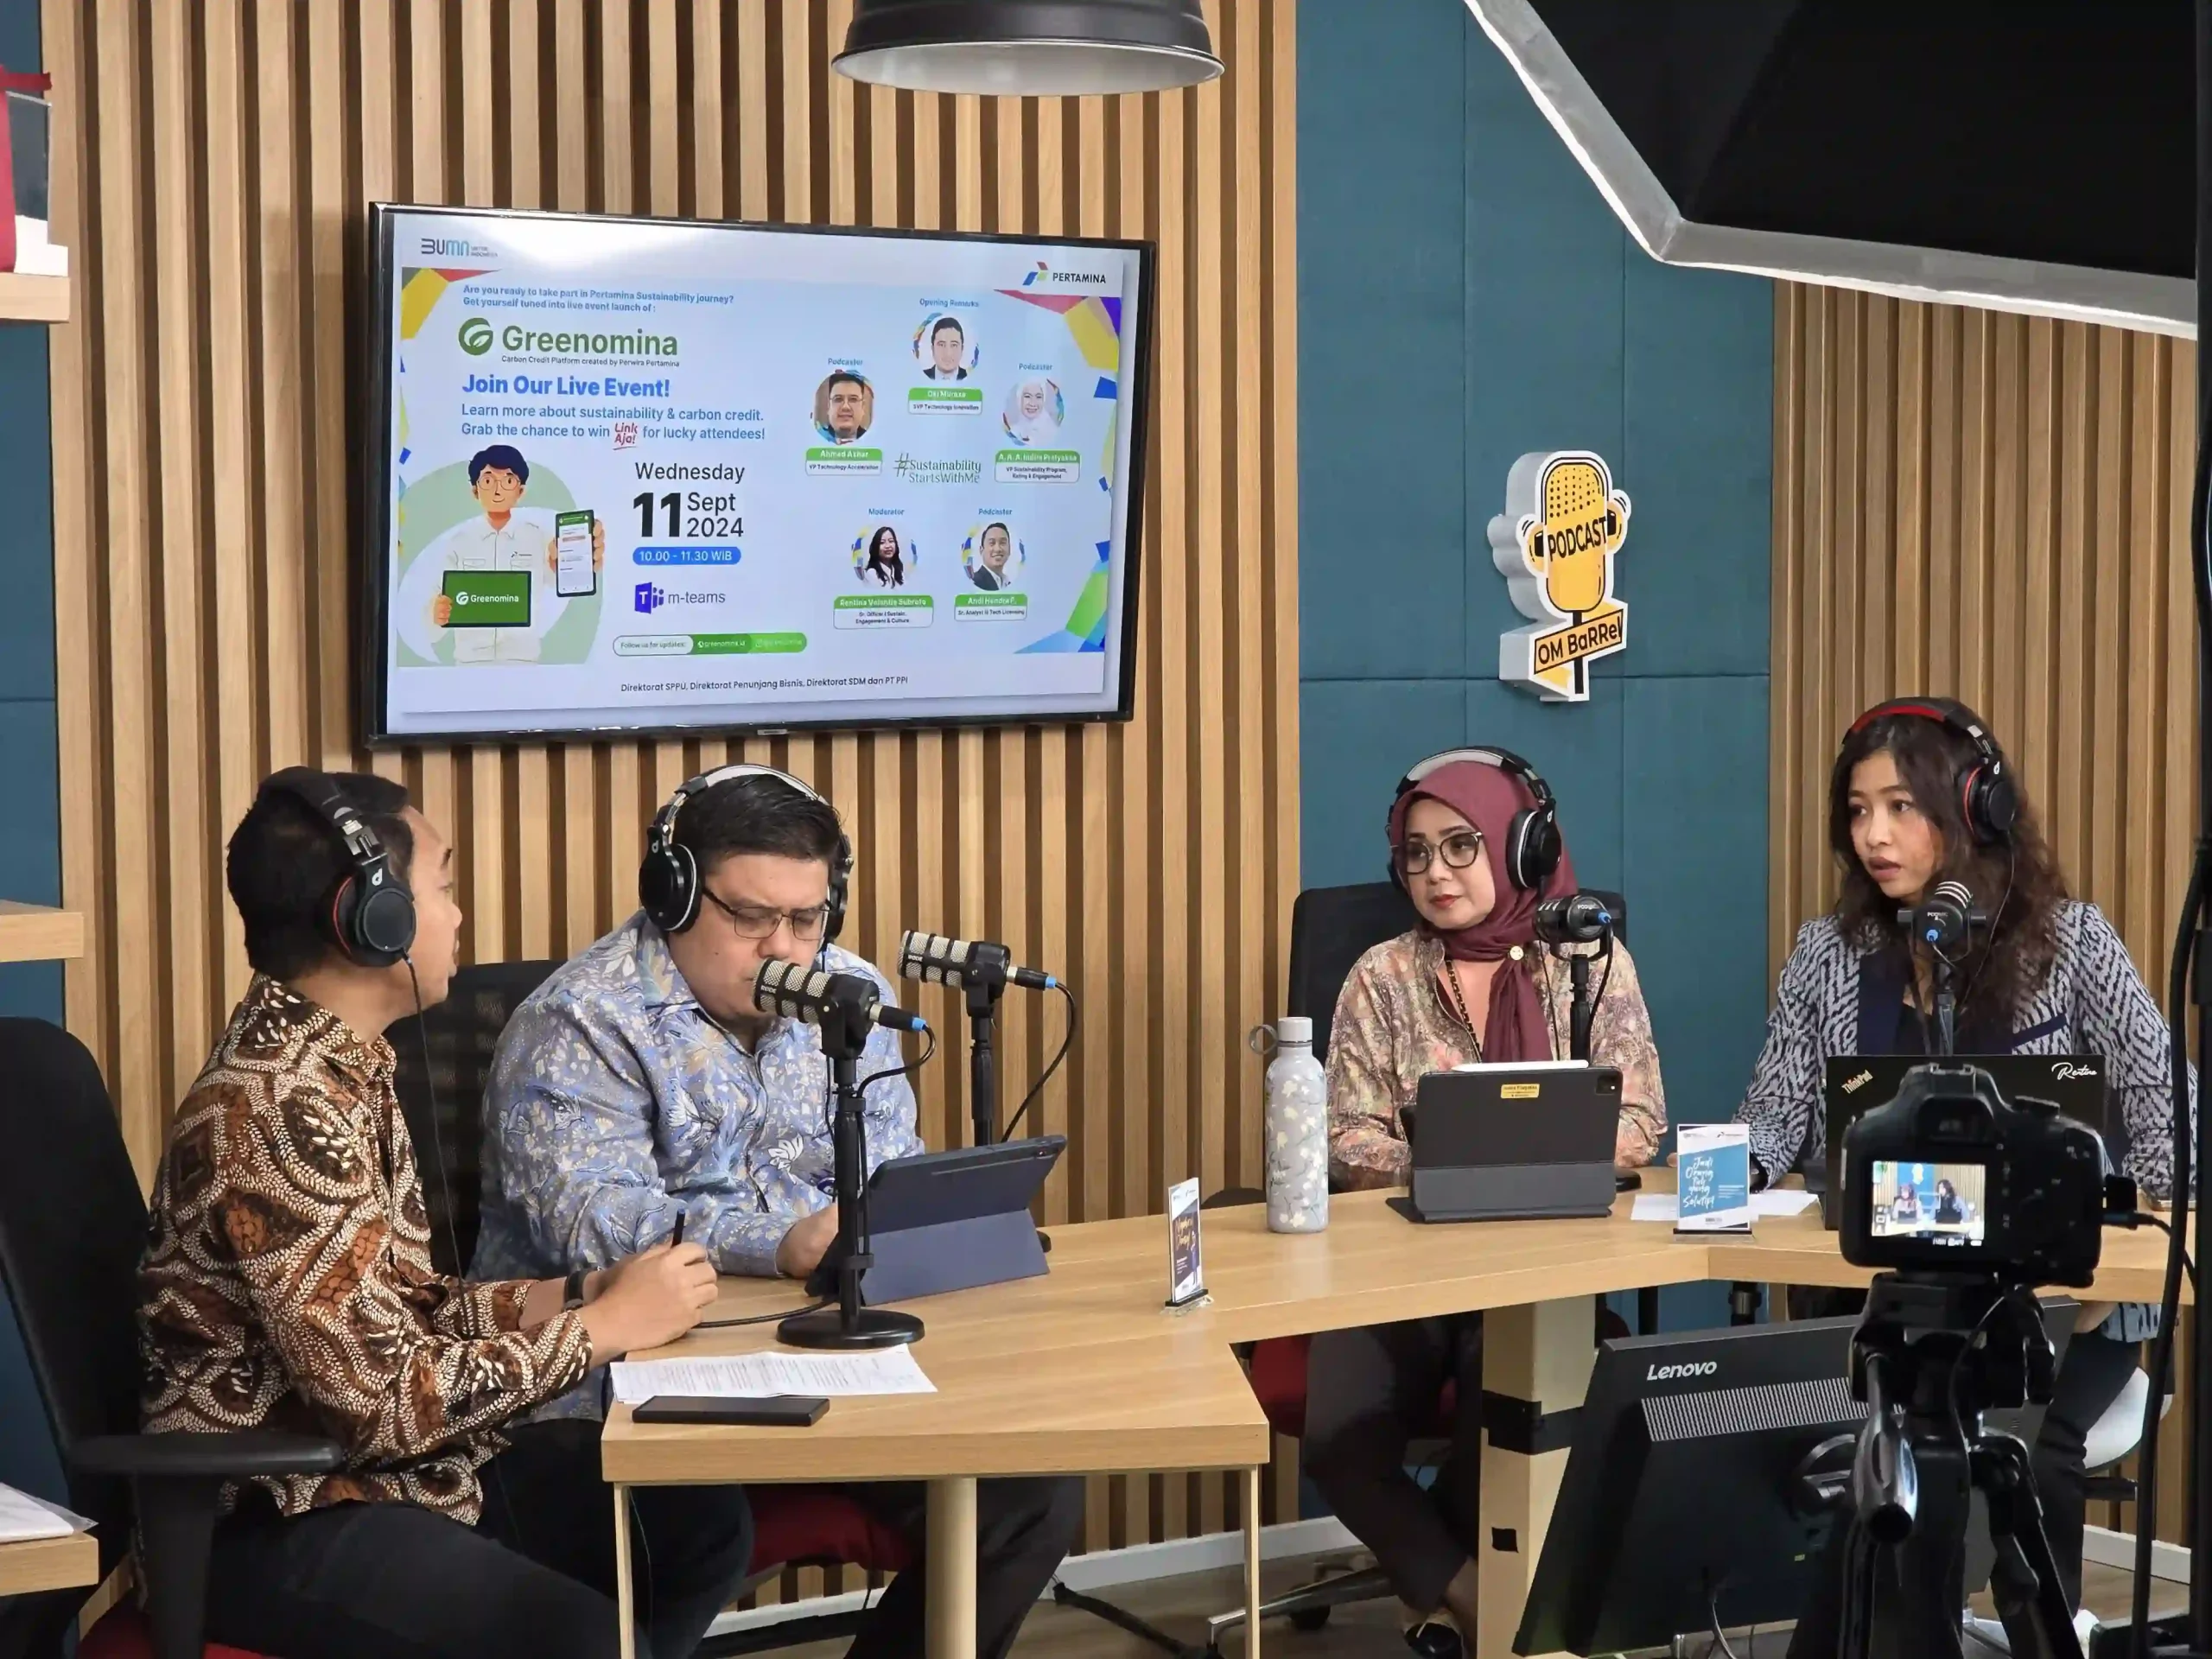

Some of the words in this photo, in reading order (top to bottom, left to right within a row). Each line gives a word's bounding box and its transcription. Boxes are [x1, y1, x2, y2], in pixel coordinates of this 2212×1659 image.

[1052, 272, 1106, 284] PERTAMINA
[463, 284, 480, 294] Are
[481, 286, 499, 296] you
[500, 286, 525, 297] ready
[528, 287, 537, 296] to
[539, 286, 558, 297] take
[560, 289, 578, 299] part
[590, 290, 635, 300] Pertamina
[636, 291, 695, 303] Sustainability
[696, 294, 734, 305] journey?
[463, 297, 480, 306] Get
[481, 298, 519, 308] yourself
[520, 298, 546, 308] tuned
[548, 299, 566, 308] into
[567, 299, 583, 309] live
[585, 302, 609, 311] event
[612, 302, 640, 312] launch
[642, 302, 652, 312] of
[919, 298, 948, 308] Opening
[950, 299, 979, 308] Remarks
[502, 325, 677, 356] Greenomina
[502, 355, 527, 364] Carbon
[529, 355, 550, 364] Credit
[609, 359, 618, 367] by
[646, 359, 679, 368] Pertamina
[461, 374, 508, 393] Join
[513, 375, 553, 395] Our
[557, 375, 600, 396] Live
[605, 378, 670, 397] Event!
[461, 404, 499, 417] Learn
[502, 406, 536, 417] more
[539, 405, 575, 418] about
[580, 406, 664, 422] sustainability
[667, 408, 675, 419] &
[678, 409, 721, 420] carbon
[725, 409, 764, 421] credit.
[461, 423, 493, 435] Grab
[496, 423, 518, 435] the
[521, 424, 568, 436] chance
[572, 425, 585, 437] to
[588, 425, 610, 437] win
[614, 422, 638, 434] Link
[643, 425, 660, 438] for
[664, 427, 696, 442] lucky
[700, 428, 765, 440] attendees!
[614, 433, 636, 446] Aja!
[635, 461, 745, 484] Wednesday
[893, 452, 982, 478] #Sustainability
[909, 473, 980, 484] StartsWithMe
[633, 492, 681, 537] 11
[687, 492, 736, 516] Sept
[687, 517, 744, 537] 2024
[1548, 515, 1607, 562] PODCAST
[639, 550, 670, 562] 10.00
[680, 550, 709, 562] 11.30
[711, 550, 732, 561] WIB
[470, 594, 519, 603] Greenomina
[668, 591, 726, 605] m-teams
[1538, 639, 1564, 664] OM
[1567, 616, 1623, 655] BaRRel
[621, 682, 664, 692] Direktorat
[690, 681, 732, 690] Direktorat
[734, 679, 778, 690] Penunjang
[779, 678, 805, 688] Bisnis,
[806, 677, 847, 687] Direktorat
[849, 677, 867, 686] SDM
[868, 676, 884, 685] dan
[885, 676, 895, 684] PT
[896, 676, 908, 684] PPI
[1841, 1069, 1873, 1094] ThinkPad
[1647, 1361, 1718, 1381] Lenovo
